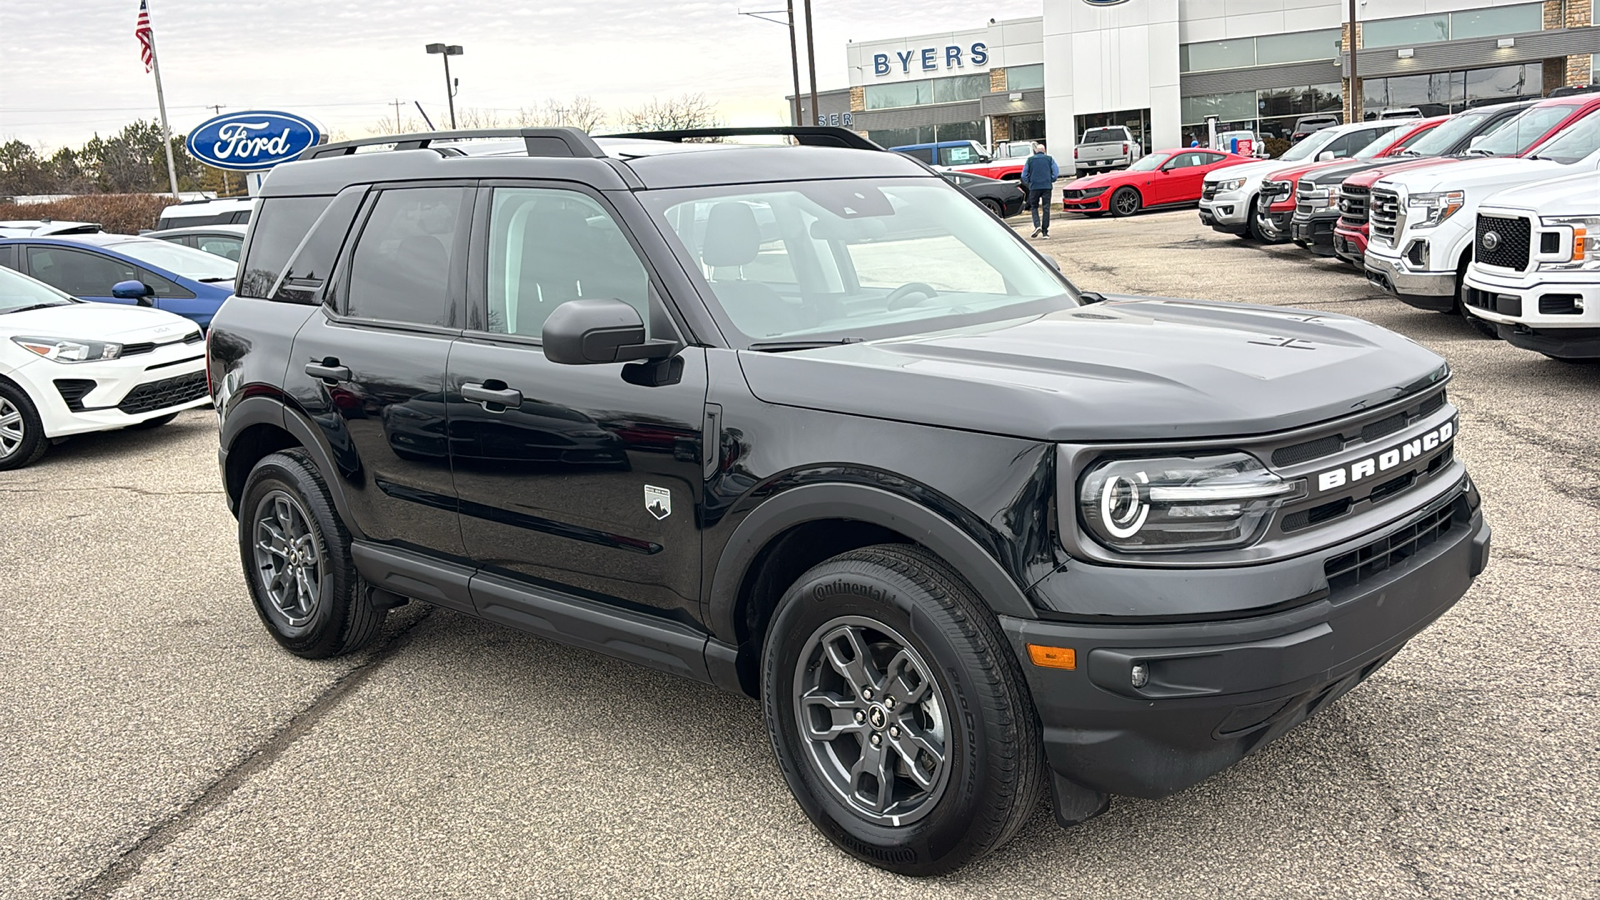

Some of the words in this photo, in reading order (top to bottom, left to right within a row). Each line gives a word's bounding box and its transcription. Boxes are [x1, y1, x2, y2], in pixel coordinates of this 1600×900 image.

[873, 42, 988, 75] BYERS
[213, 121, 291, 159] Ford
[1318, 421, 1453, 492] BRONCO
[812, 578, 888, 604] Continental
